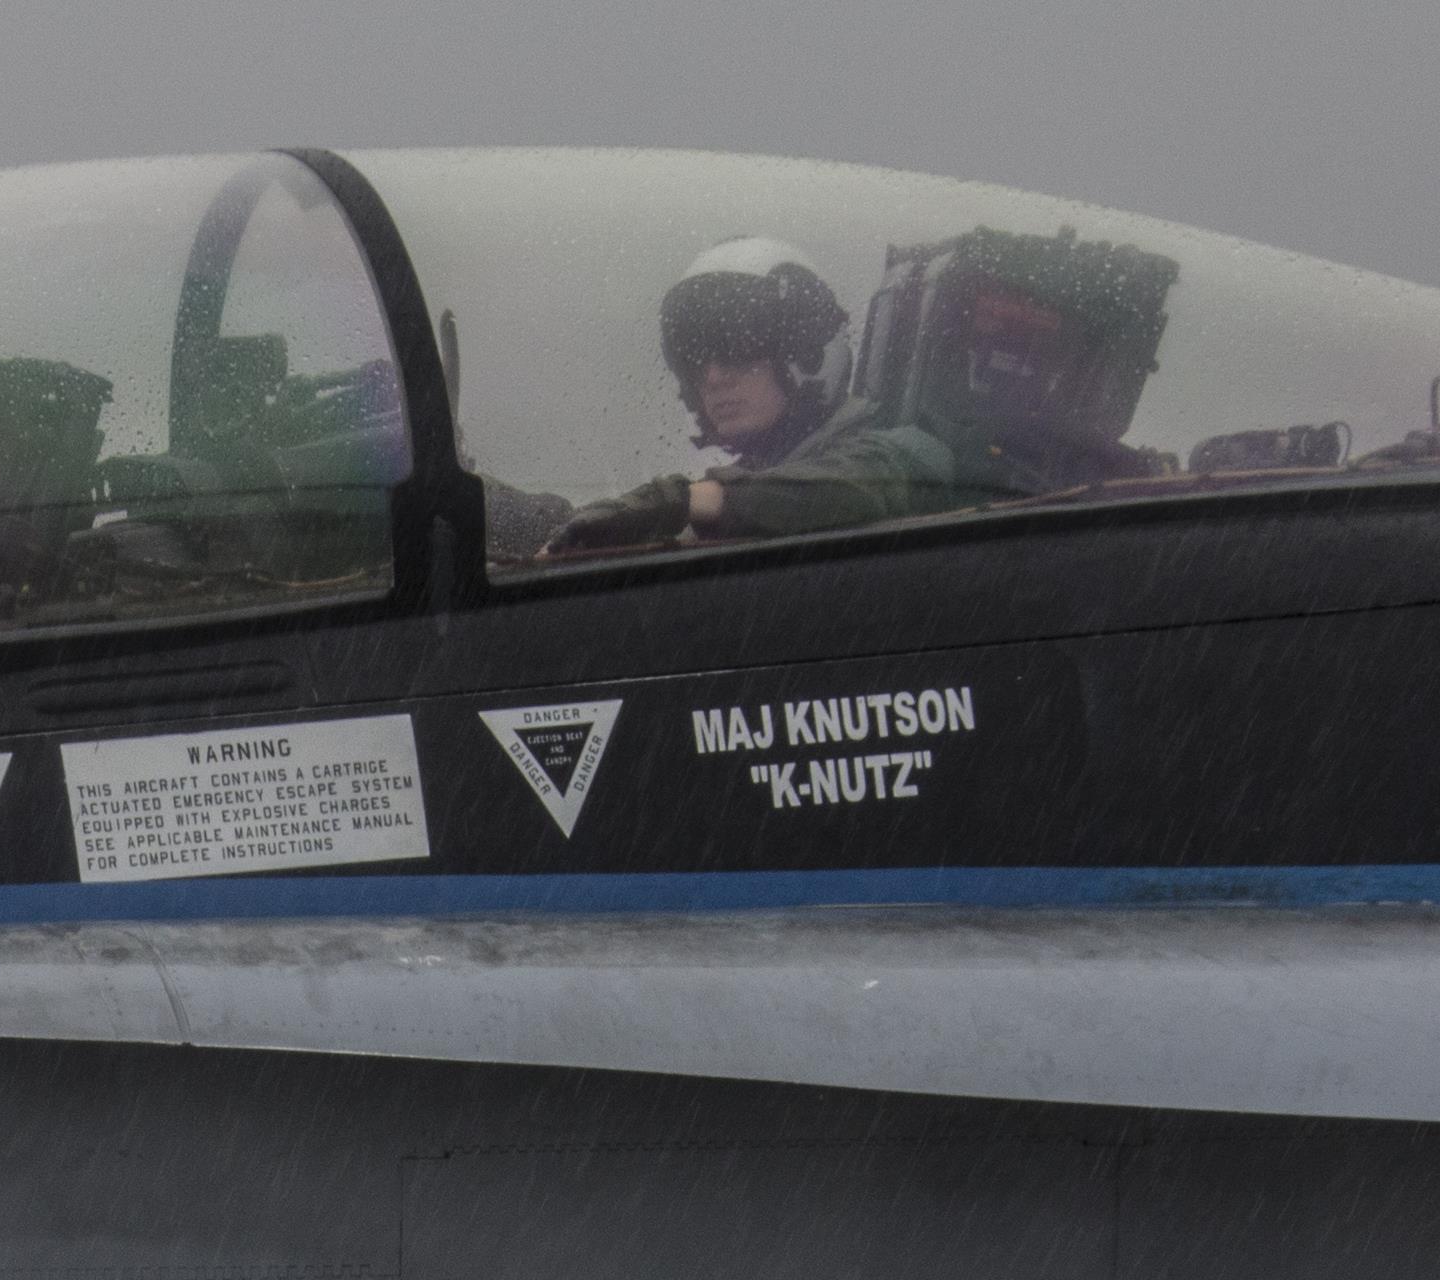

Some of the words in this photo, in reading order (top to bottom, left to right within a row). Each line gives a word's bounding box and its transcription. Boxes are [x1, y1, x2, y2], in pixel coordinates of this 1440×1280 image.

[523, 708, 581, 724] DANGER
[692, 704, 774, 753] MAJ
[784, 686, 975, 745] KNUTSON
[187, 738, 292, 765] WARNING
[510, 742, 551, 795] DANGER
[574, 735, 603, 792] DANGER
[77, 784, 113, 799] THIS
[124, 776, 199, 795] AIRCRAFT
[211, 769, 287, 788] CONTAINS
[296, 767, 305, 780] A
[312, 760, 388, 778] CARTRIGE
[80, 797, 162, 816] ACTUATED
[173, 789, 264, 809] EMERGENCY
[276, 782, 338, 800] ESCAPE
[351, 776, 413, 793] SYSTEM
[750, 750, 932, 808] "K-NUTZ"
[82, 815, 165, 834] EQUIPPED
[176, 812, 211, 827] WITH
[222, 803, 308, 823] EXPLOSIVE
[319, 796, 391, 814] CHARGES
[84, 838, 115, 852] SEE
[127, 829, 223, 849] APPLICABLE
[234, 818, 341, 839] MAINTENANCE
[352, 812, 413, 830] MANUAL
[88, 856, 118, 870] FOR
[129, 848, 211, 868] COMPLETE
[222, 837, 334, 859] INSTRUCTIONS
